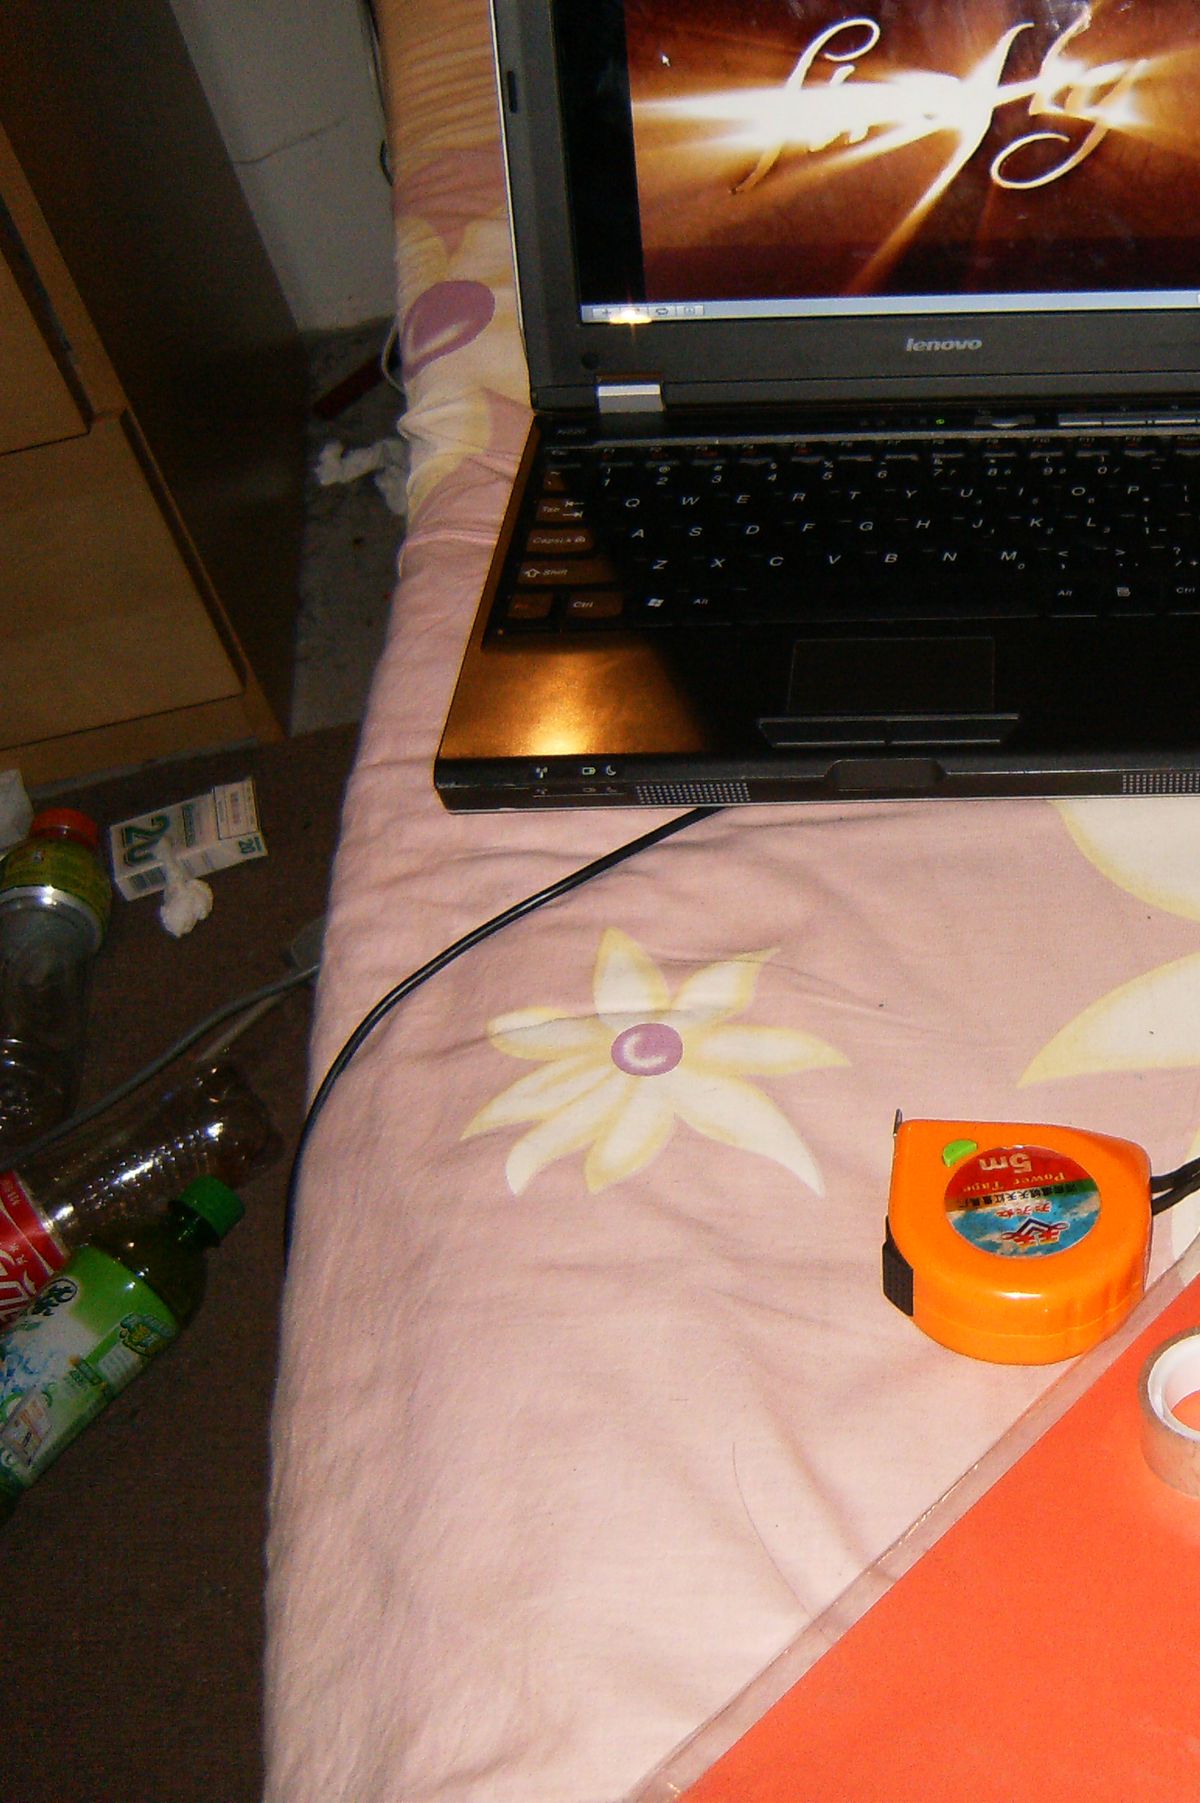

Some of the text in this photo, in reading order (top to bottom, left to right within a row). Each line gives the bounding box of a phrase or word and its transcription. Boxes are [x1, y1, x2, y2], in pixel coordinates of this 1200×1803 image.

[905, 337, 983, 352] lenovo
[624, 497, 641, 508] Q
[681, 496, 700, 506] W
[736, 494, 750, 504] E
[792, 492, 806, 502] R
[849, 490, 861, 500] T
[905, 489, 917, 498] Y
[959, 488, 974, 498] U
[1071, 486, 1086, 497] O
[1127, 485, 1140, 495] P
[631, 528, 645, 538] A
[688, 526, 703, 537] S
[745, 524, 760, 535] D
[802, 522, 815, 532] F
[859, 521, 874, 531] G
[915, 519, 931, 529] H
[972, 518, 984, 529] J
[1029, 517, 1043, 528] K
[1086, 517, 1096, 527] L
[652, 559, 668, 570] Z
[710, 558, 725, 568] X
[768, 556, 784, 567] C
[828, 555, 841, 565] V
[884, 553, 898, 563] B
[942, 551, 958, 562] N
[1000, 550, 1018, 561] M
[979, 1152, 1033, 1174] 5m
[963, 1171, 1066, 1193] Power Tape
